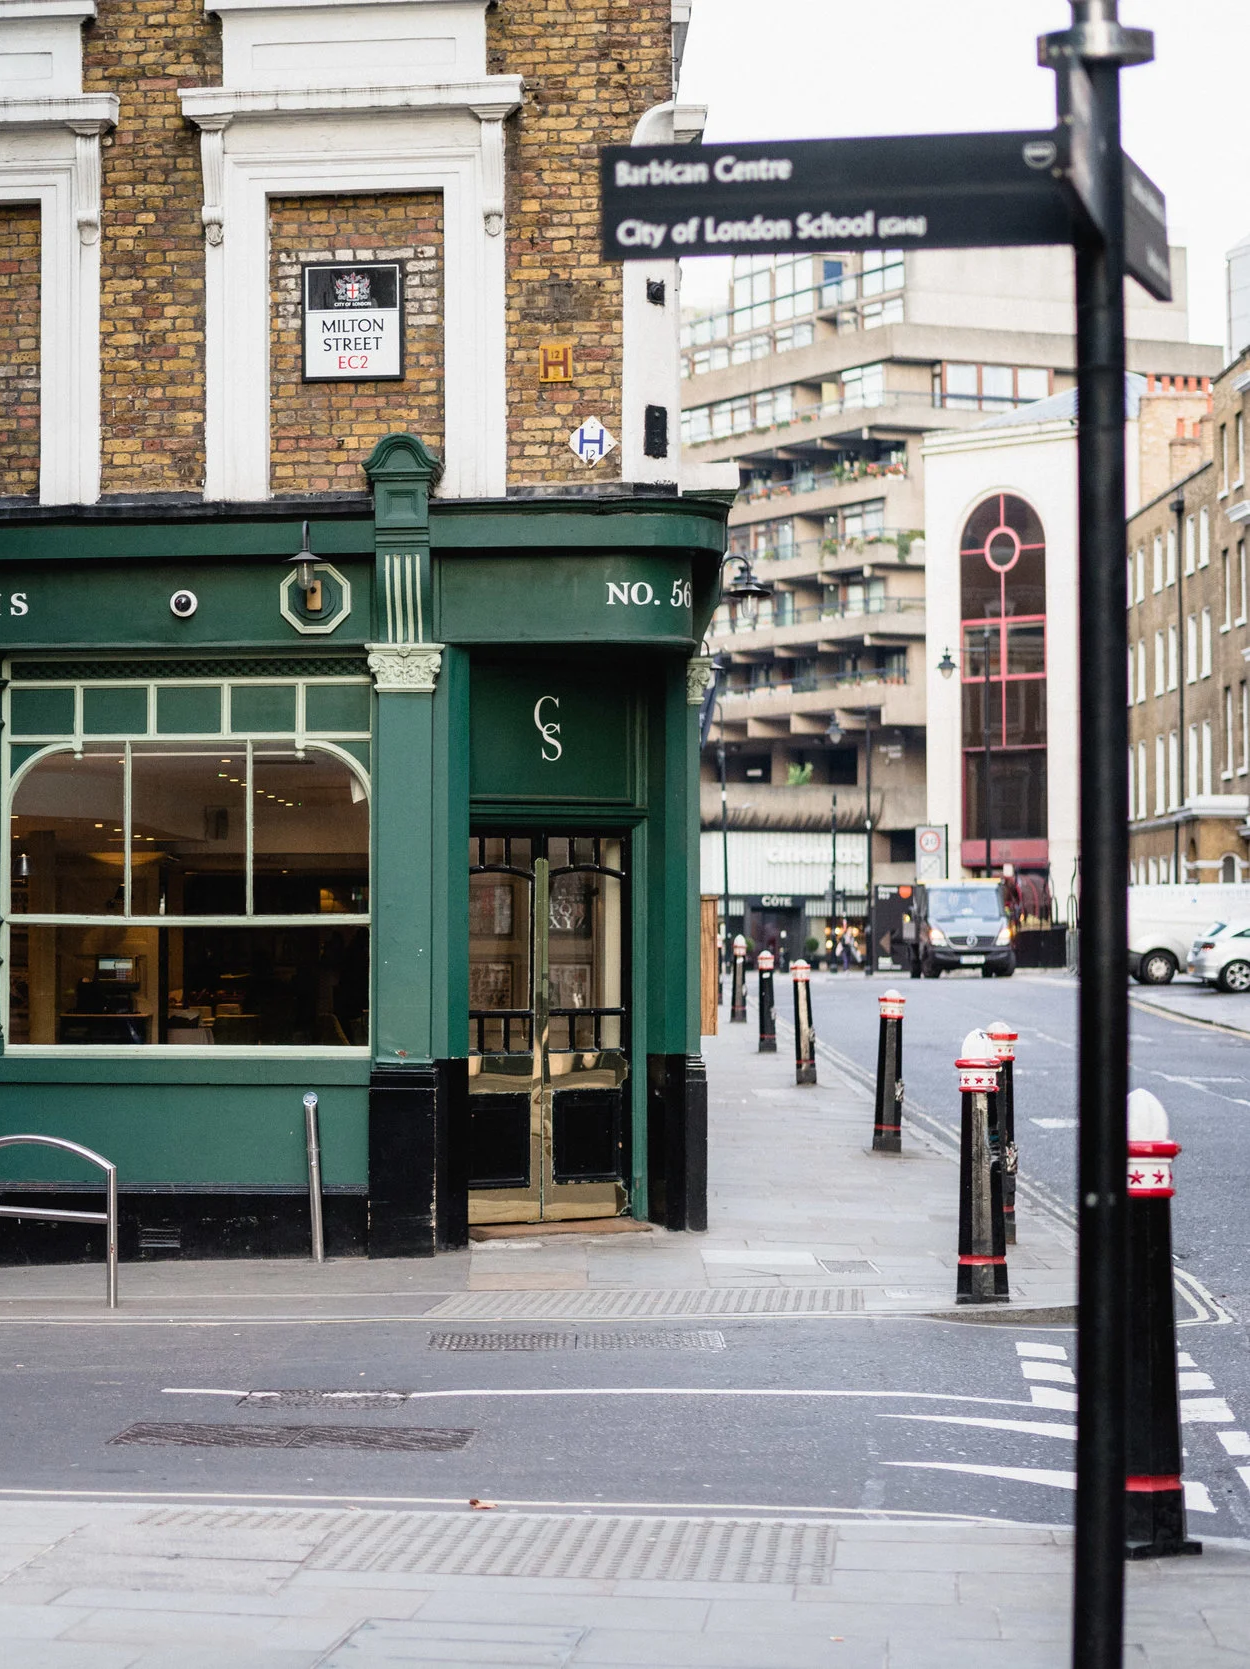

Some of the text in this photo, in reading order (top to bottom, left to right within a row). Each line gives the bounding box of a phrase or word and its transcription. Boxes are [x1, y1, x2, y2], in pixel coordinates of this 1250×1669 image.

[615, 156, 792, 186] Barbican Centre
[616, 219, 667, 248] City
[671, 216, 700, 244] of
[704, 214, 792, 243] London
[796, 210, 875, 239] School
[322, 318, 384, 333] MILTON
[323, 336, 382, 351] STREET
[550, 350, 560, 359] 12
[338, 355, 368, 369] EC2
[543, 347, 568, 379] H
[579, 428, 604, 455] H
[606, 578, 691, 608] NO. 56
